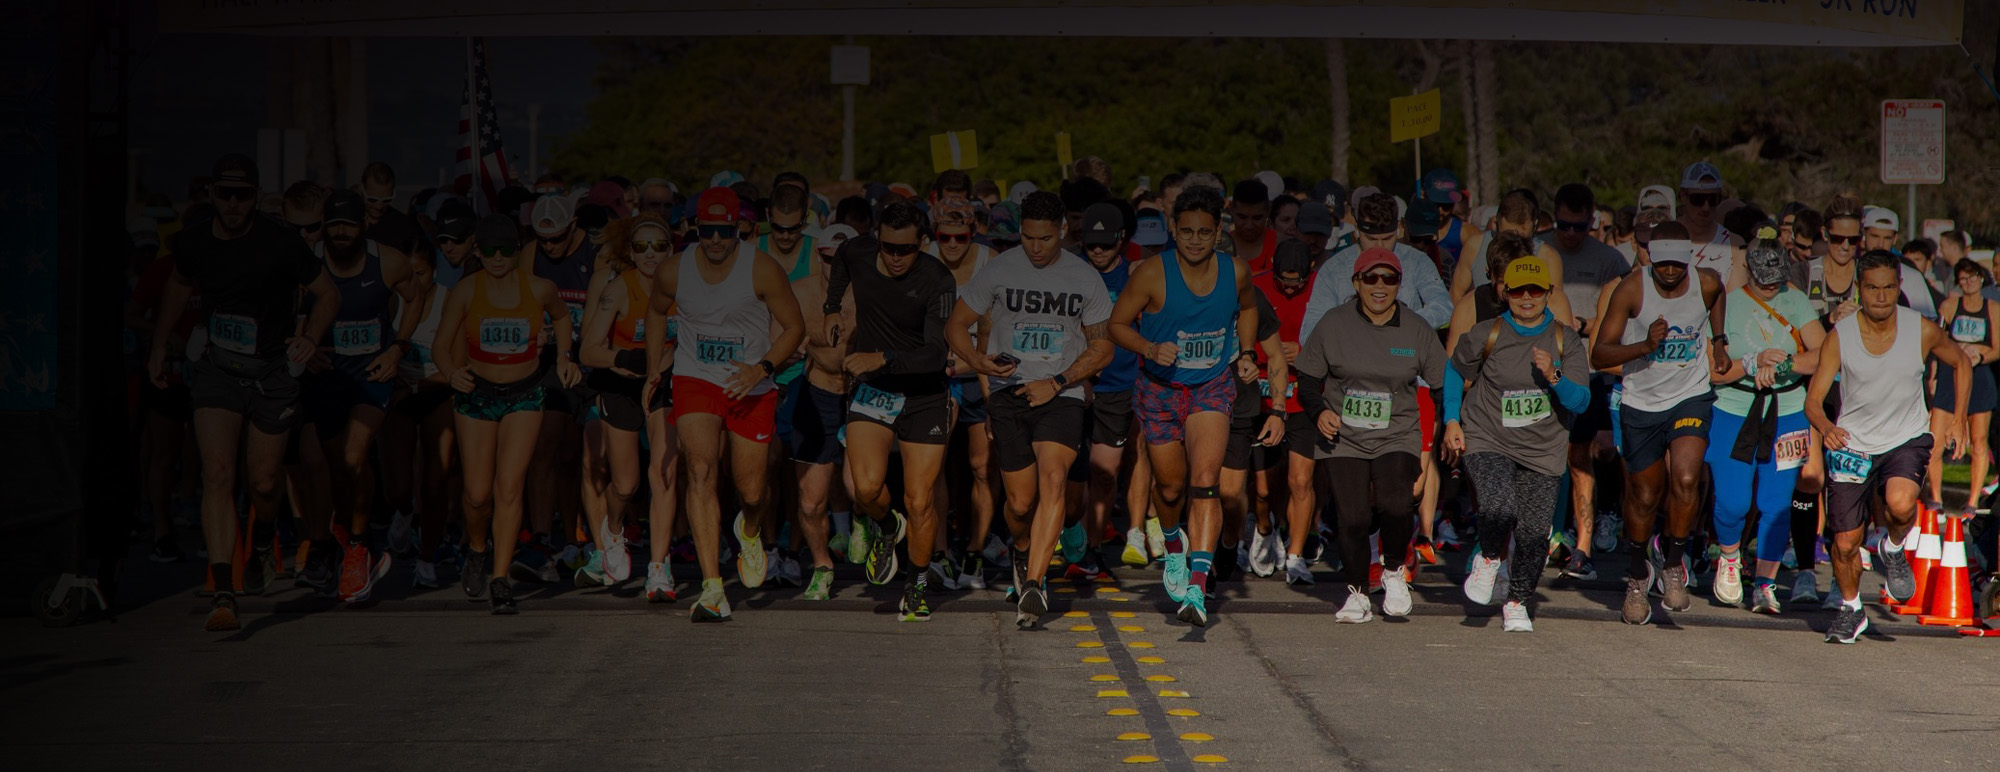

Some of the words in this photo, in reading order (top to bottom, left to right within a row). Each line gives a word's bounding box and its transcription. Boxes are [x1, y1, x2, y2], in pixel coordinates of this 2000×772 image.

[1515, 263, 1542, 273] POLO
[1005, 287, 1084, 317] USMC
[340, 329, 369, 345] 483
[484, 327, 521, 343] 1316
[1021, 332, 1050, 350] 710
[699, 343, 734, 361] 1421
[1184, 340, 1213, 358] 900
[857, 388, 895, 411] 1265
[1345, 398, 1382, 418] 4133
[1505, 398, 1543, 416] 4132
[1674, 417, 1703, 430] NAVY
[1777, 438, 1808, 459] 3094
